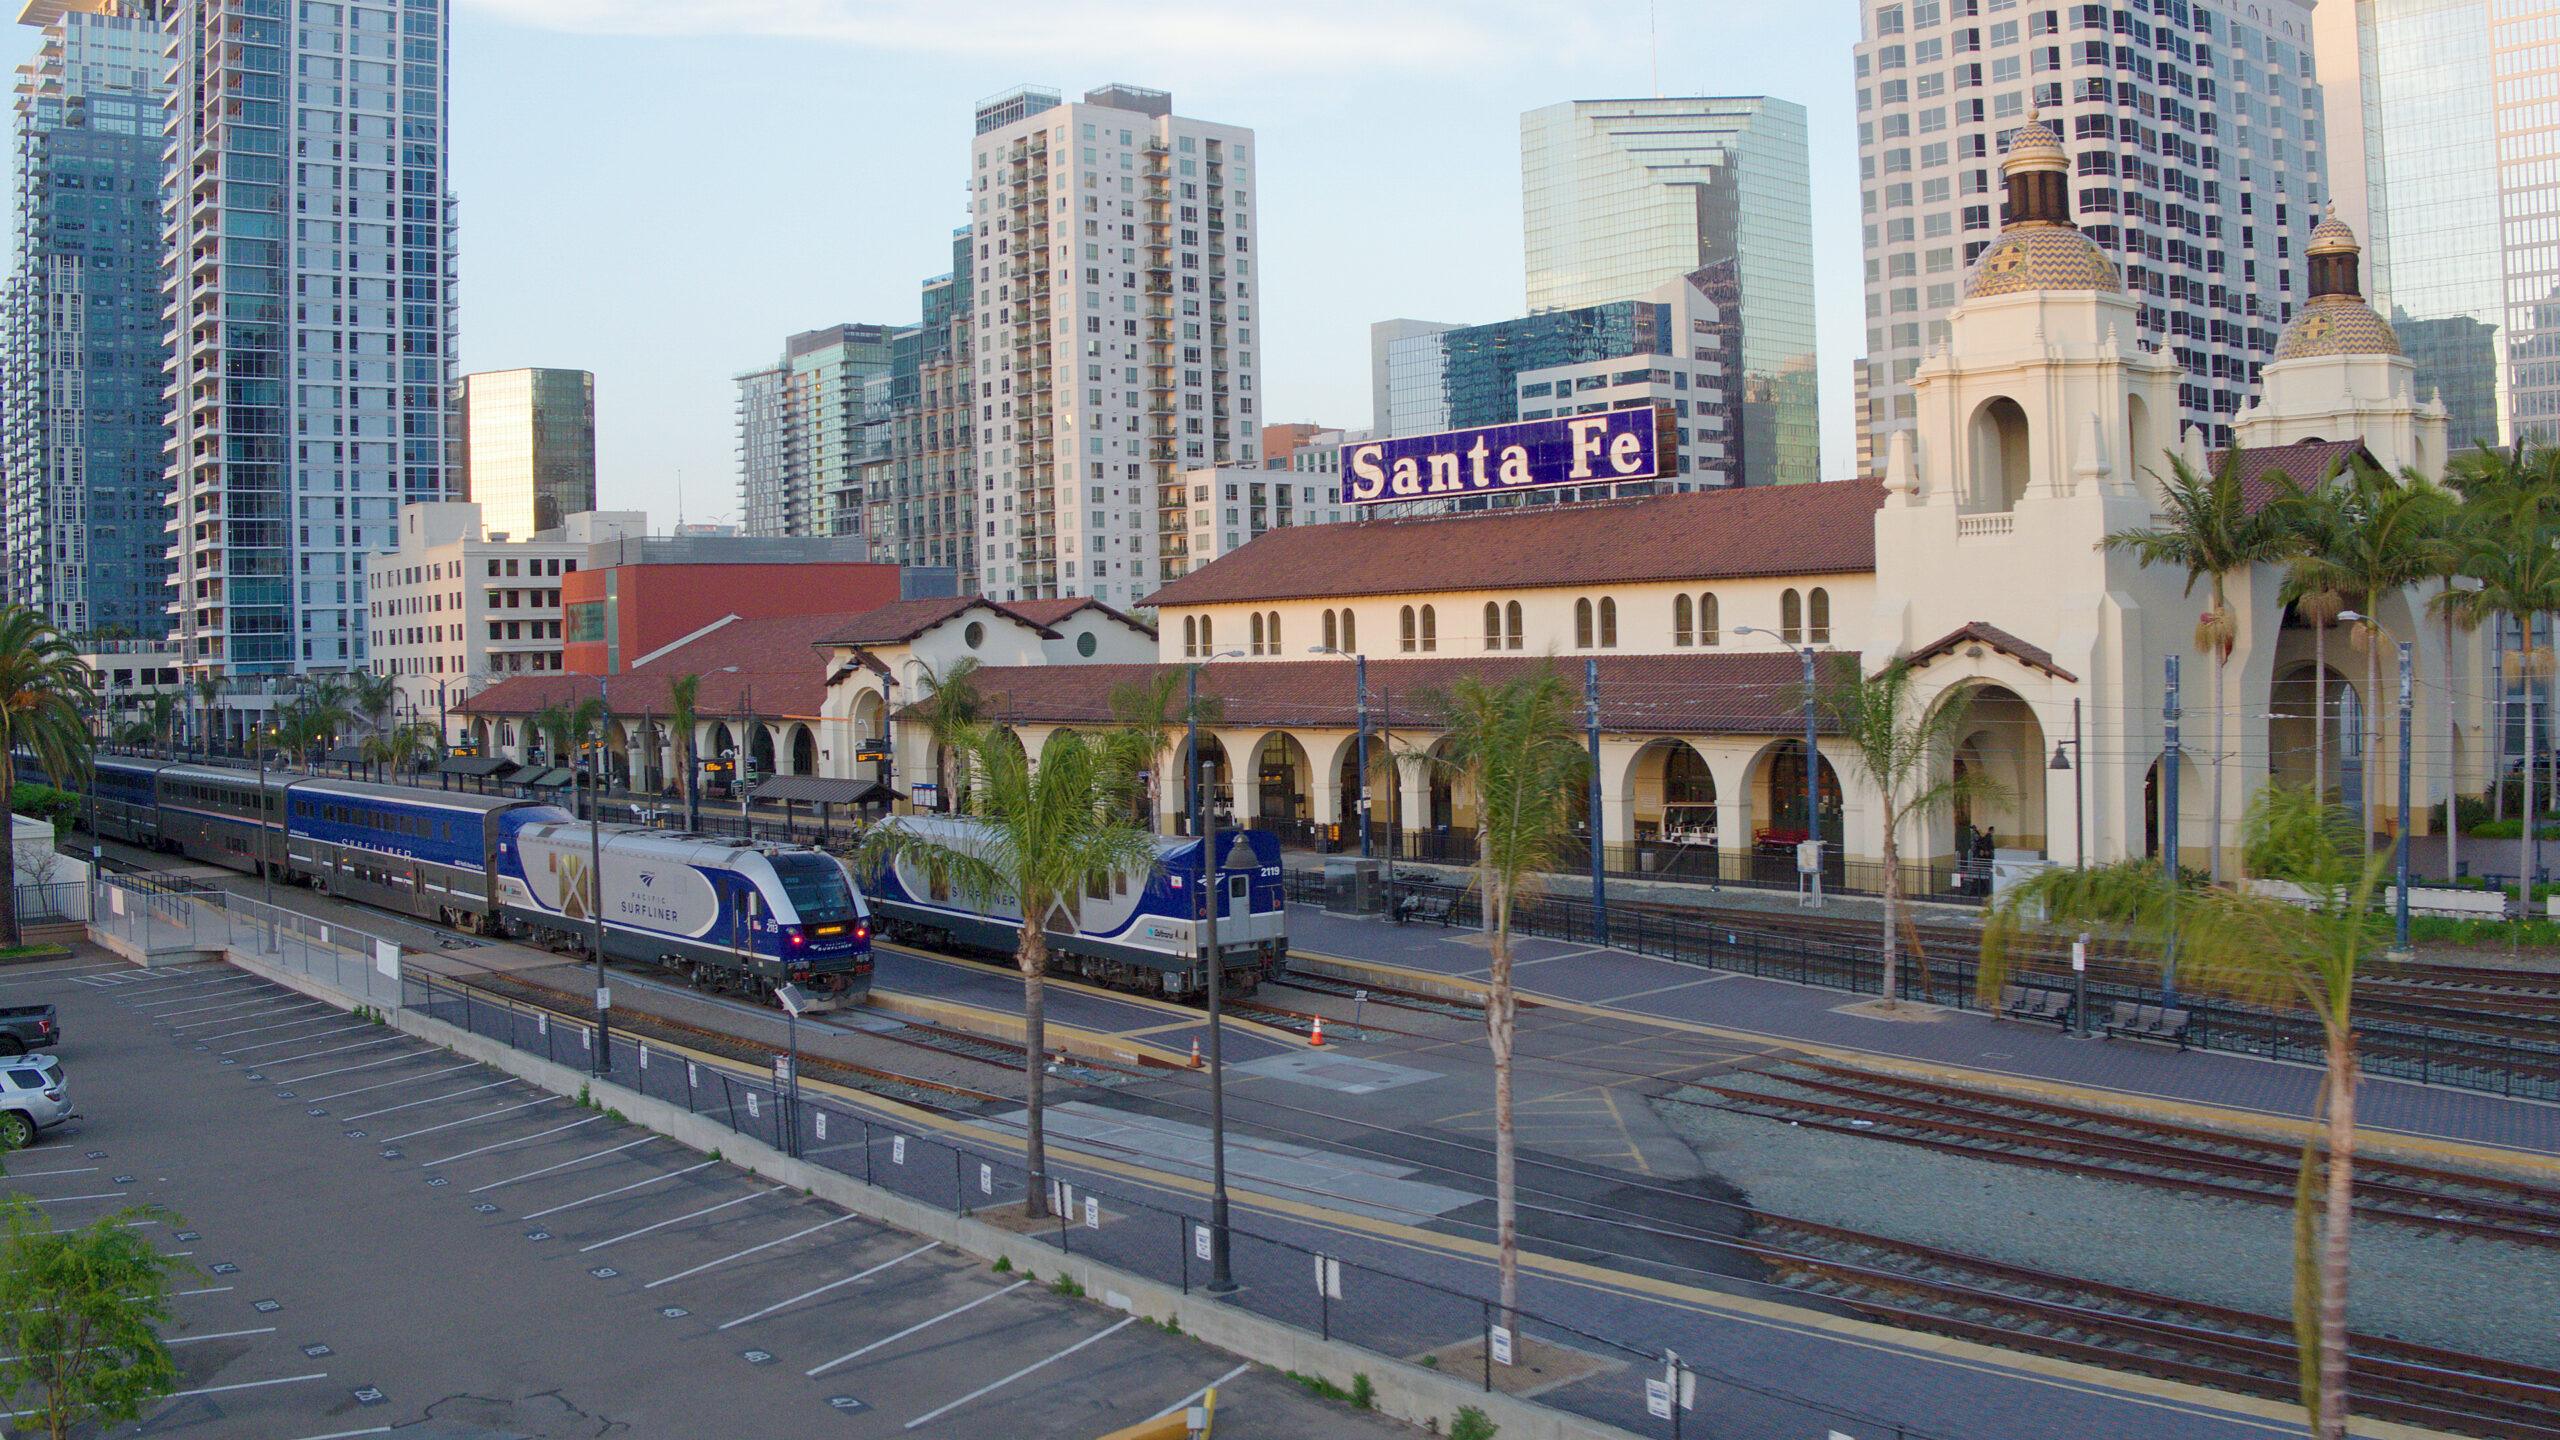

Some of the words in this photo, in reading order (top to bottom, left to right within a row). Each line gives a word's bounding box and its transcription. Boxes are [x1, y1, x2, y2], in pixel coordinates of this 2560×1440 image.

[1352, 435, 1533, 500] Santa
[1568, 418, 1642, 479] Fe
[341, 838, 413, 863] SURFLINER
[1260, 866, 1280, 877] 2119
[631, 892, 667, 905] PACIFIC
[951, 886, 1016, 907] SURFNER
[620, 901, 679, 922] SURFLINER
[817, 943, 853, 952] SURFLINER
[743, 1351, 771, 1363] 48
[354, 1387, 383, 1402] 82
[831, 1397, 861, 1408] 47
